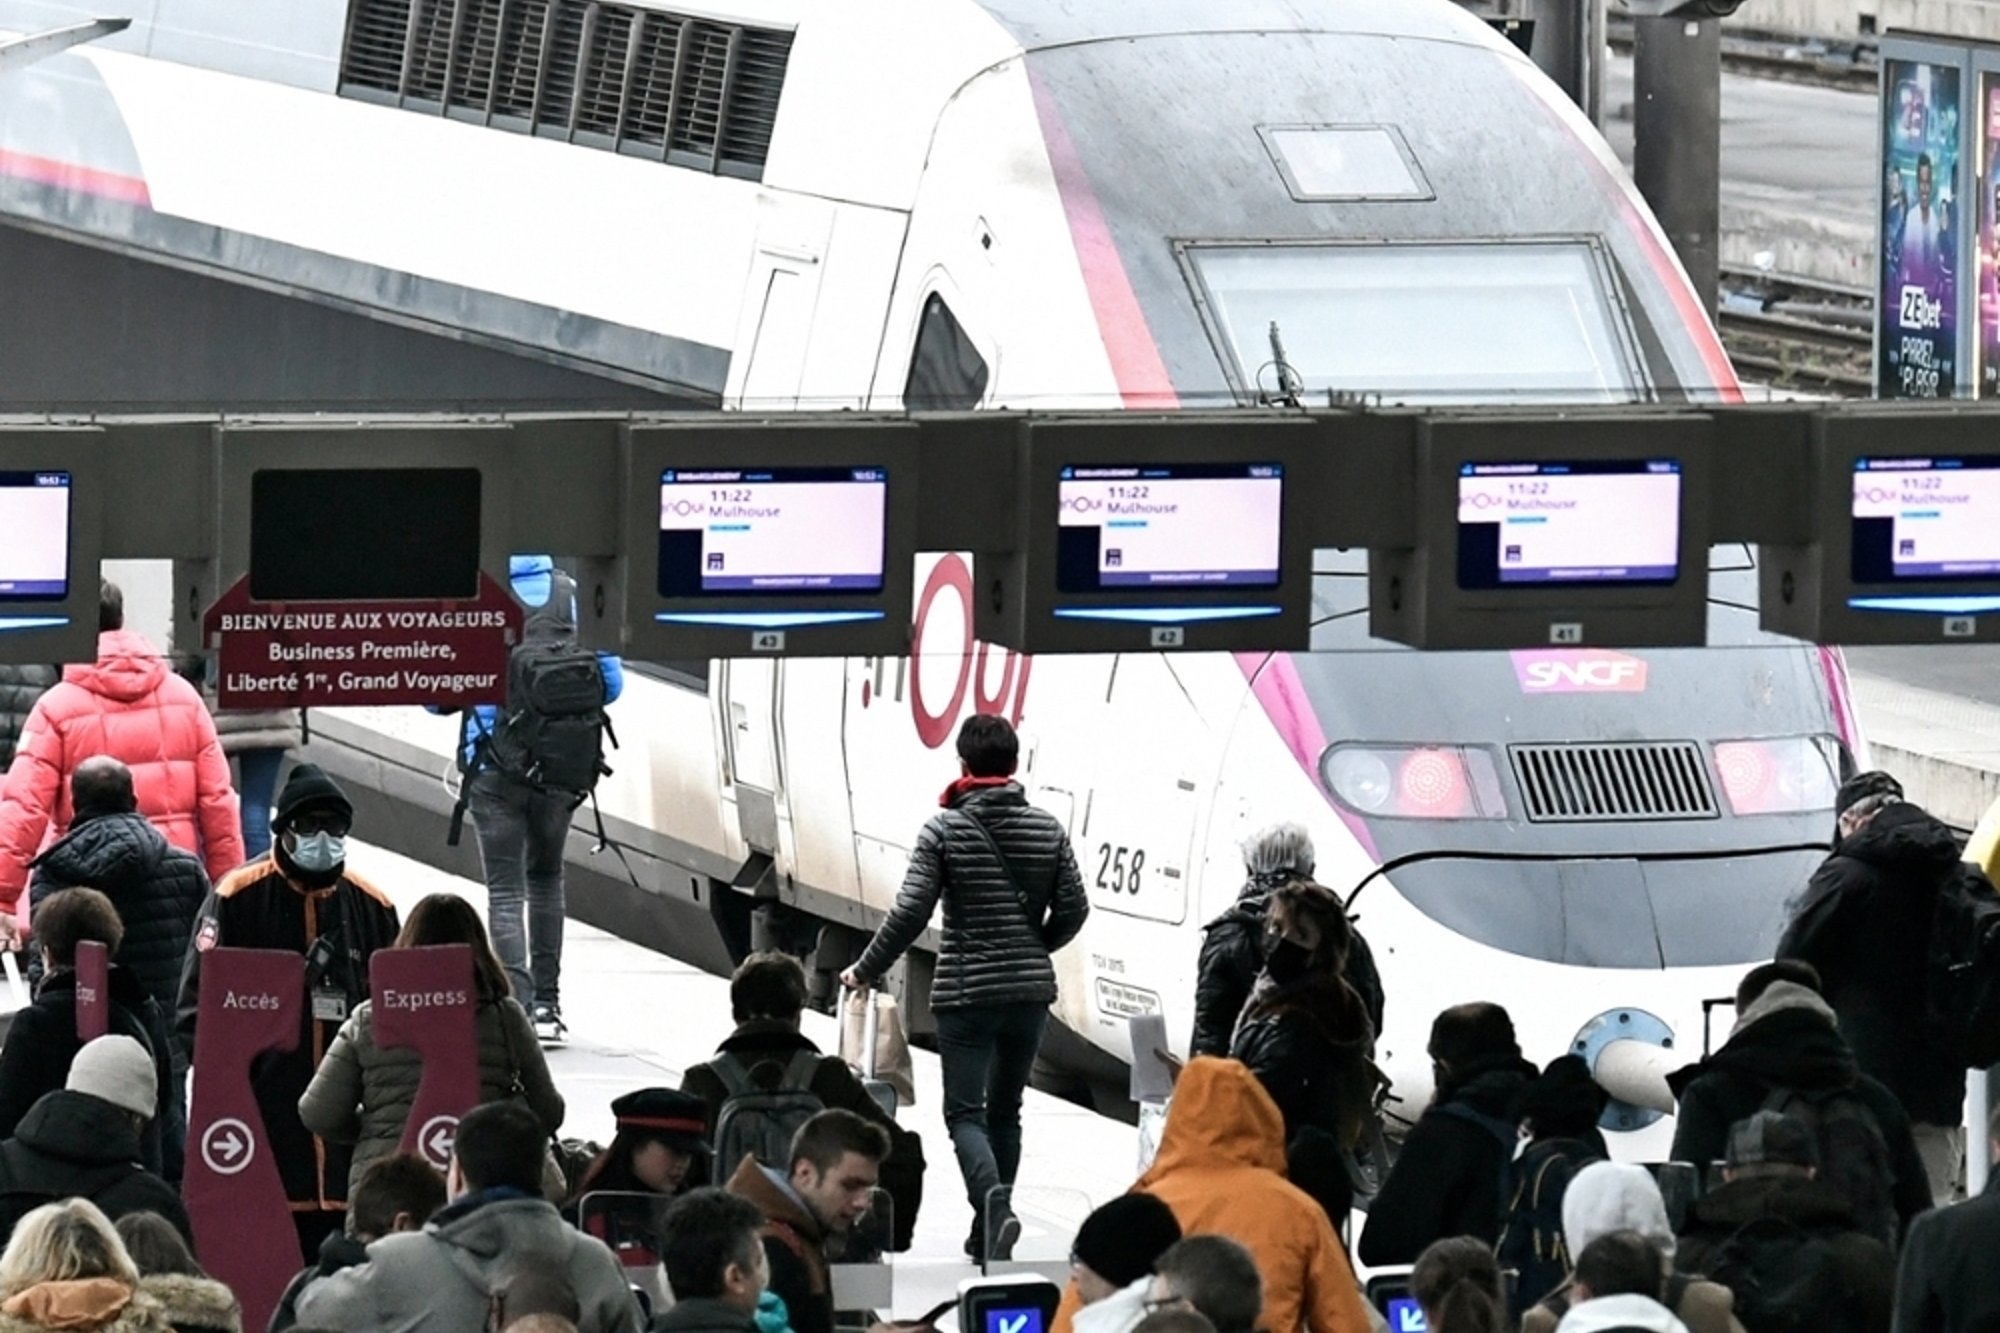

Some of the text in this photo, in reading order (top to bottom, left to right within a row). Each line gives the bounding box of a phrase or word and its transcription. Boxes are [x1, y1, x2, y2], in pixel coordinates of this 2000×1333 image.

[1508, 482, 1549, 495] 11:22
[1902, 477, 1942, 490] 11:22
[710, 489, 752, 502] 11:22
[1107, 486, 1149, 499] 11:22
[709, 505, 781, 518] Mulhouse
[1107, 502, 1178, 514] Mulhouse
[221, 611, 506, 631] BIENVENUE AUX VOYAGEURS
[1951, 620, 1969, 633] 40
[1158, 631, 1177, 644] 42
[1556, 628, 1575, 640] 41
[759, 635, 777, 648] 43
[269, 640, 457, 662] Business Première,
[1525, 661, 1638, 687] SNCF
[227, 671, 299, 692] Liberté
[337, 669, 399, 691] Grand
[402, 669, 498, 694] Voyageur
[1095, 842, 1146, 896] 258
[223, 990, 280, 1011] Accès
[382, 989, 468, 1012] Express
